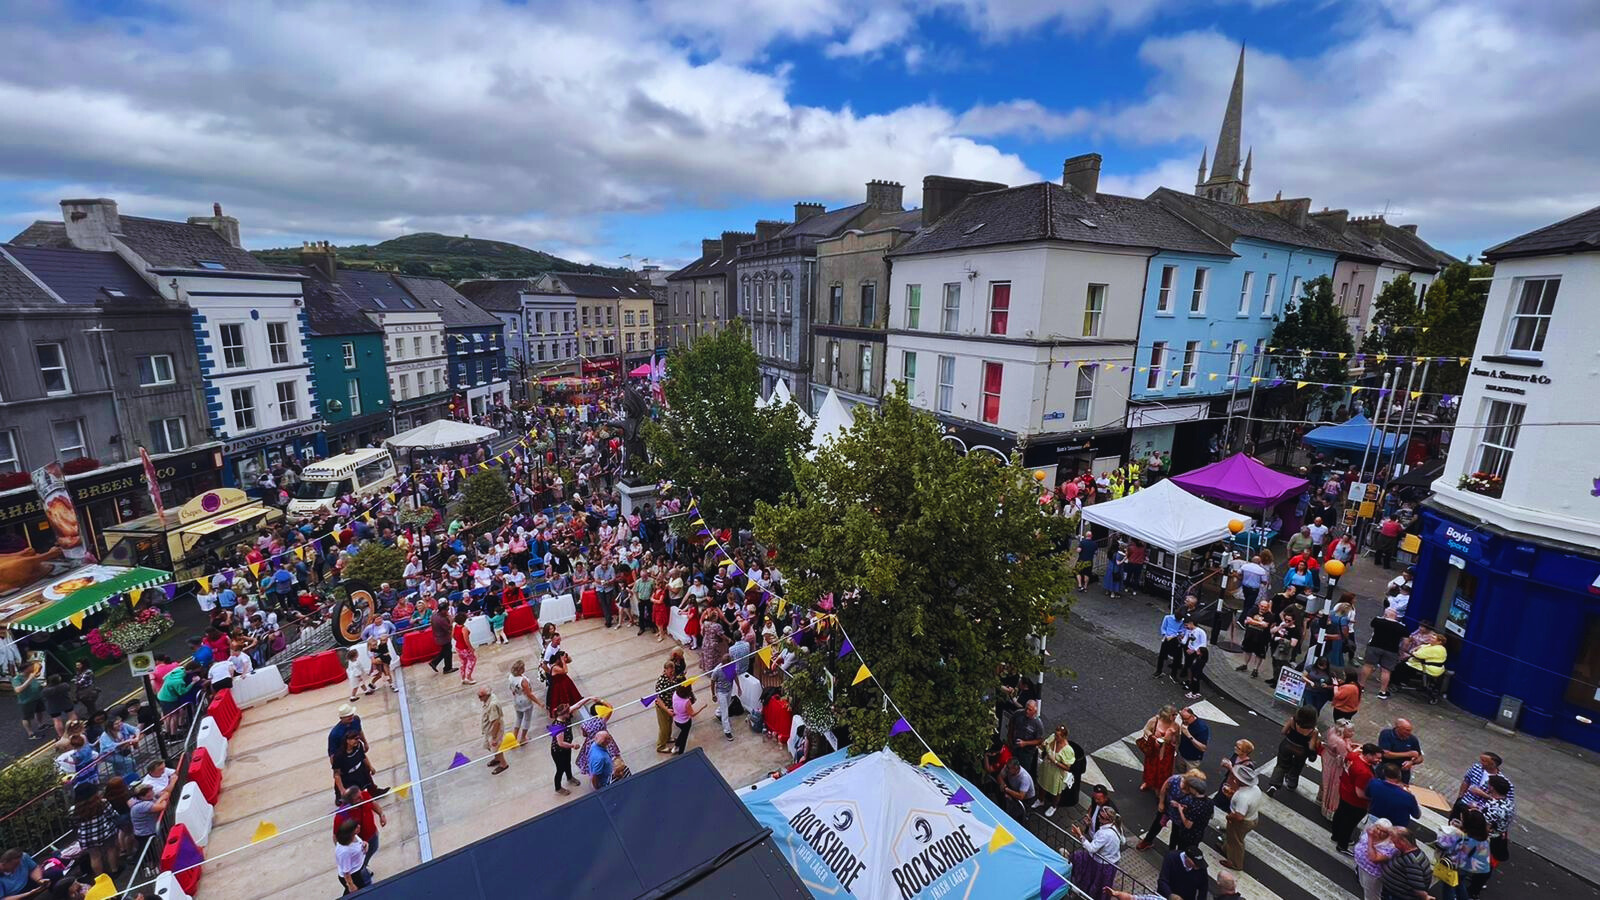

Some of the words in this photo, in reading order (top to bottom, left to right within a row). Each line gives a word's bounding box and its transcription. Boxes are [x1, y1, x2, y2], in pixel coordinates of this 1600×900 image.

[1530, 374, 1537, 383] &
[232, 436, 273, 452] JENNINGS
[275, 425, 314, 439] OPTICIANS
[77, 477, 134, 500] BREEN
[156, 466, 176, 479] CO
[1446, 526, 1472, 544] Boyle
[1447, 539, 1469, 553] Sports
[788, 806, 867, 894] ROCKSHORE
[796, 843, 814, 864] IRISH
[810, 858, 829, 882] LAGER
[891, 824, 980, 900] ROCKSHORE
[931, 879, 951, 900] IRISH
[948, 867, 969, 887] LAGER
